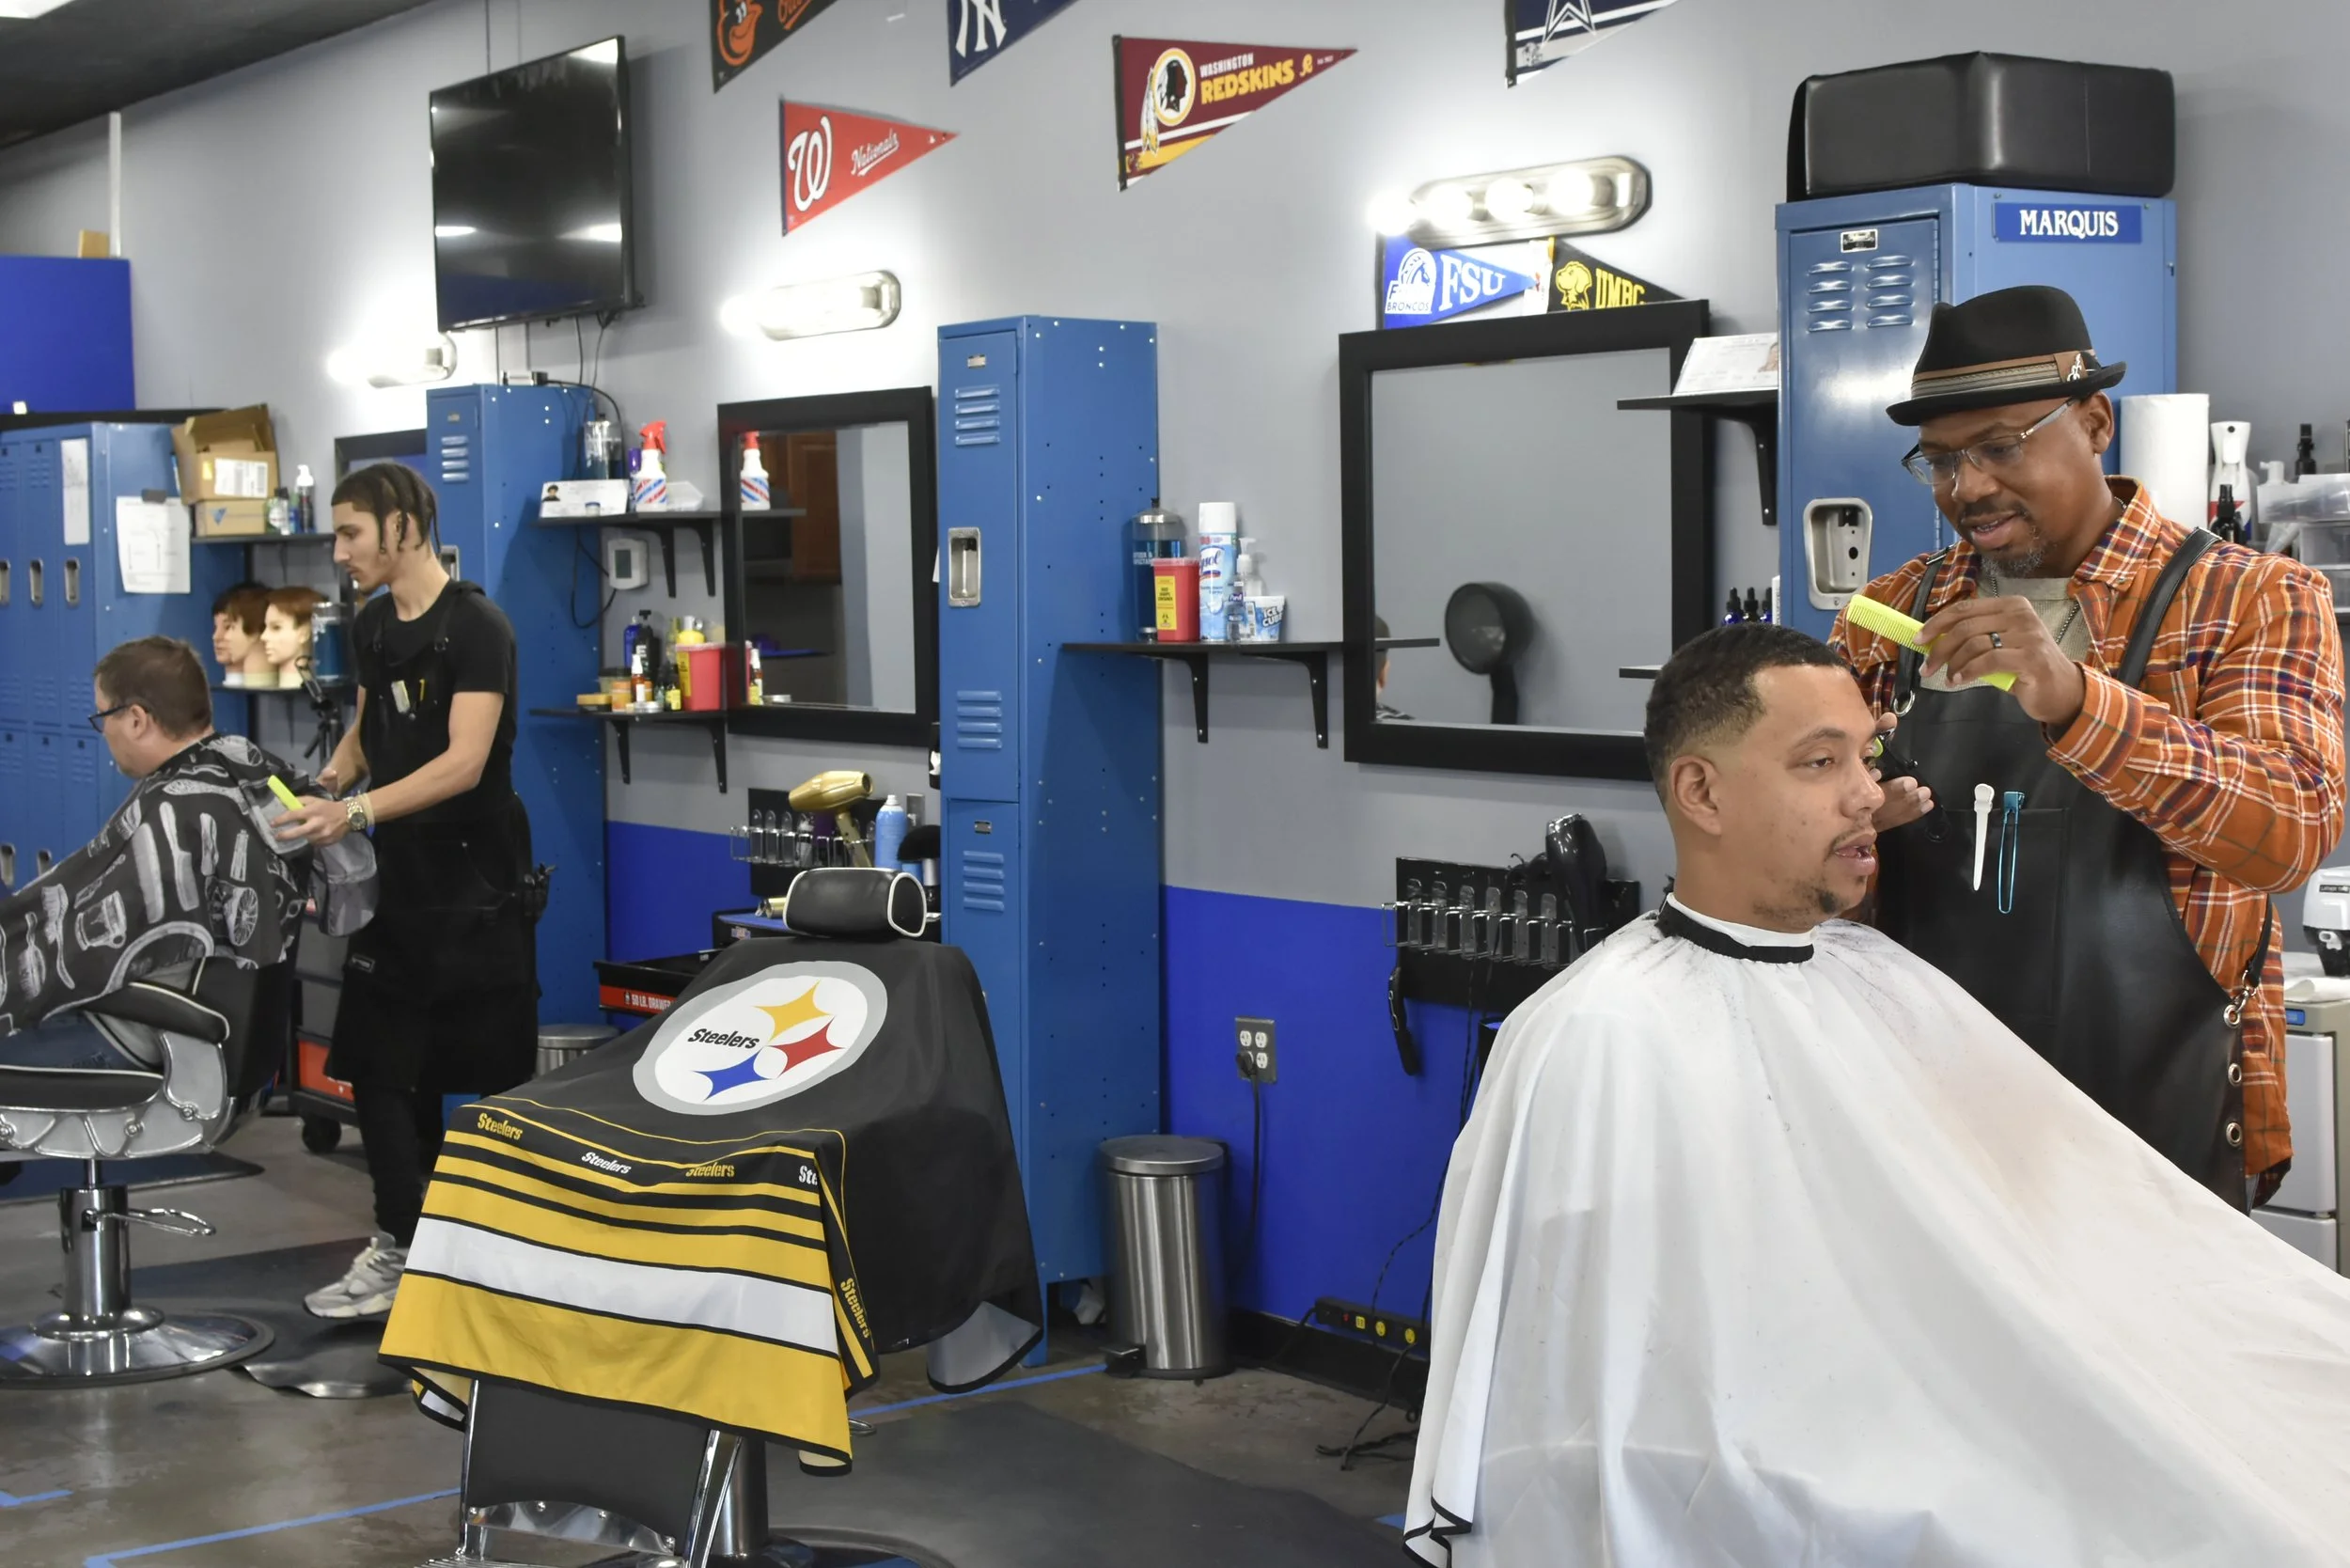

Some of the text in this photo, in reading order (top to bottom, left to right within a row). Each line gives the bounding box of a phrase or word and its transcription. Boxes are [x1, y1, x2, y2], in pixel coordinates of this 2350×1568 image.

[1199, 53, 1254, 78] WASHINGTON
[1200, 58, 1295, 105] REDSKINS
[788, 116, 832, 212] W
[851, 127, 900, 177] Nationals
[2019, 210, 2119, 240] MARQUIS
[1438, 254, 1507, 312] FSU
[1595, 268, 1645, 309] UMBC
[1386, 301, 1430, 312] BRONCOS
[1263, 606, 1277, 618] ICE
[687, 1027, 760, 1049] Steelers
[477, 1112, 523, 1141] Steelers
[581, 1152, 632, 1175] Steelers
[840, 1278, 870, 1339] Steelers
